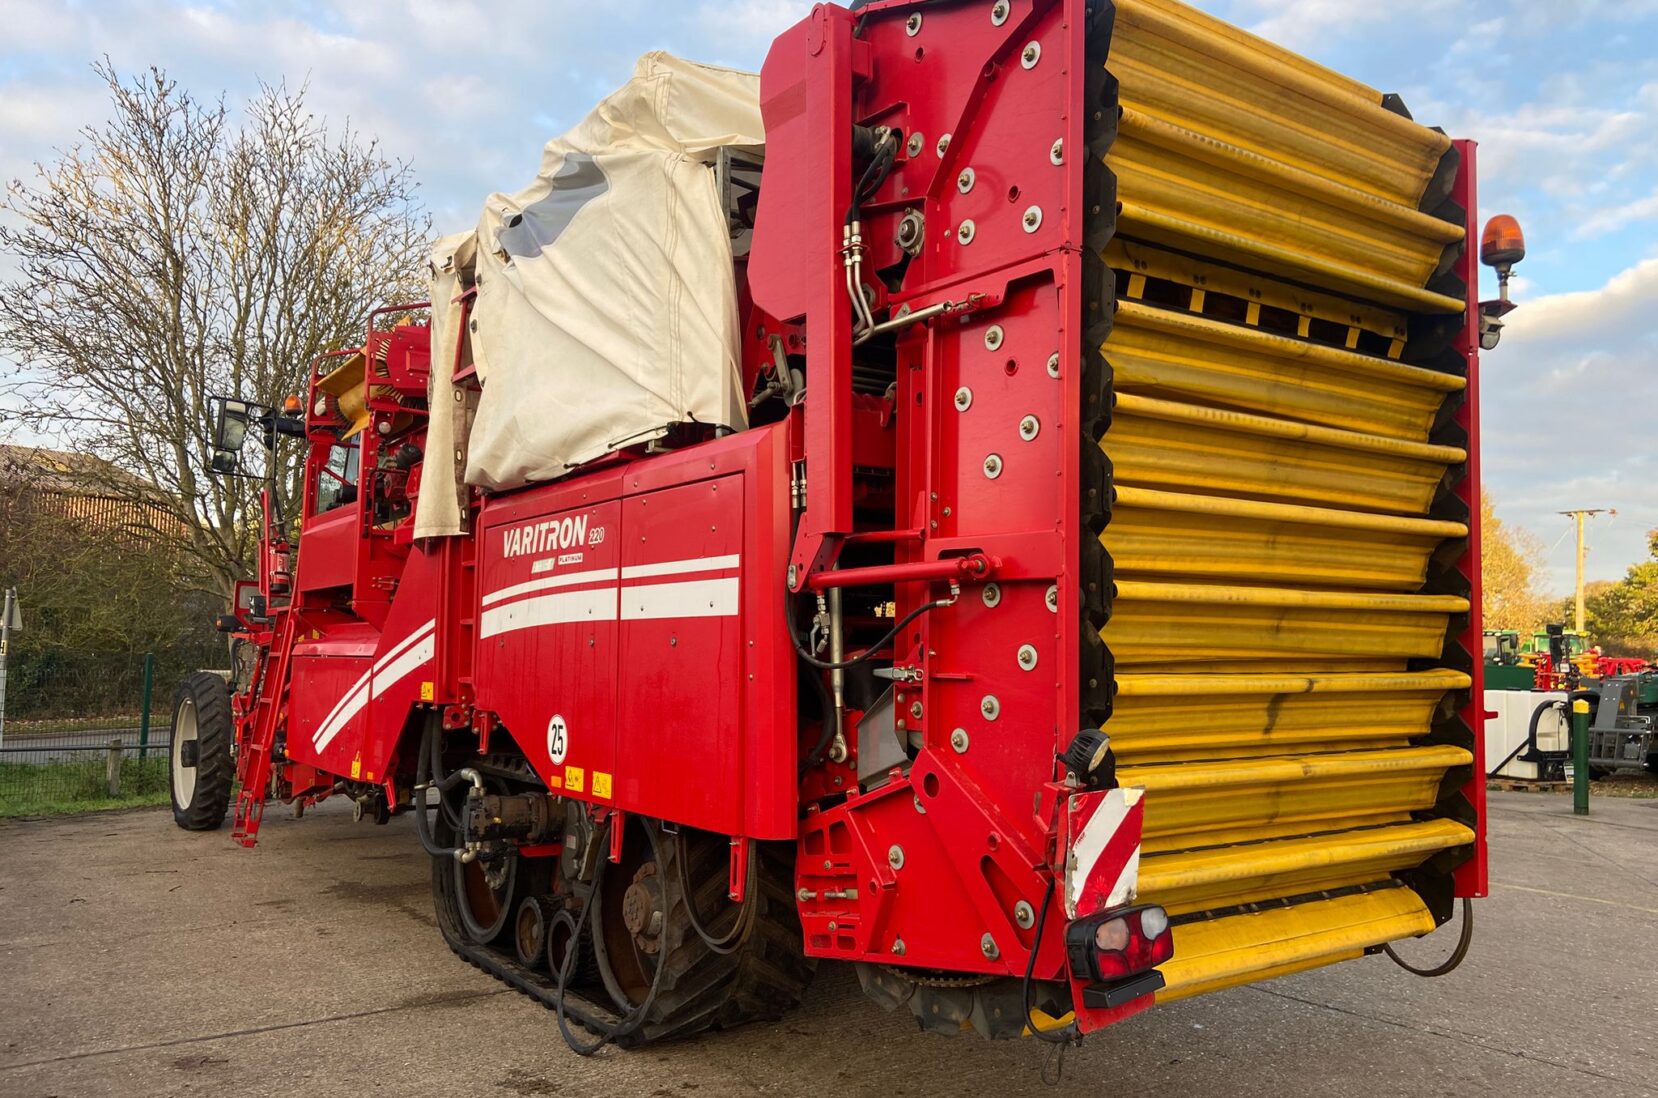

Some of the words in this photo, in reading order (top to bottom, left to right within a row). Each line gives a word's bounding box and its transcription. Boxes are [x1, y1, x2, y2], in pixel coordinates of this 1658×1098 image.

[503, 514, 588, 558] VARITRON
[588, 527, 605, 545] 220
[559, 553, 582, 564] PLATINUM
[551, 723, 564, 756] 25
